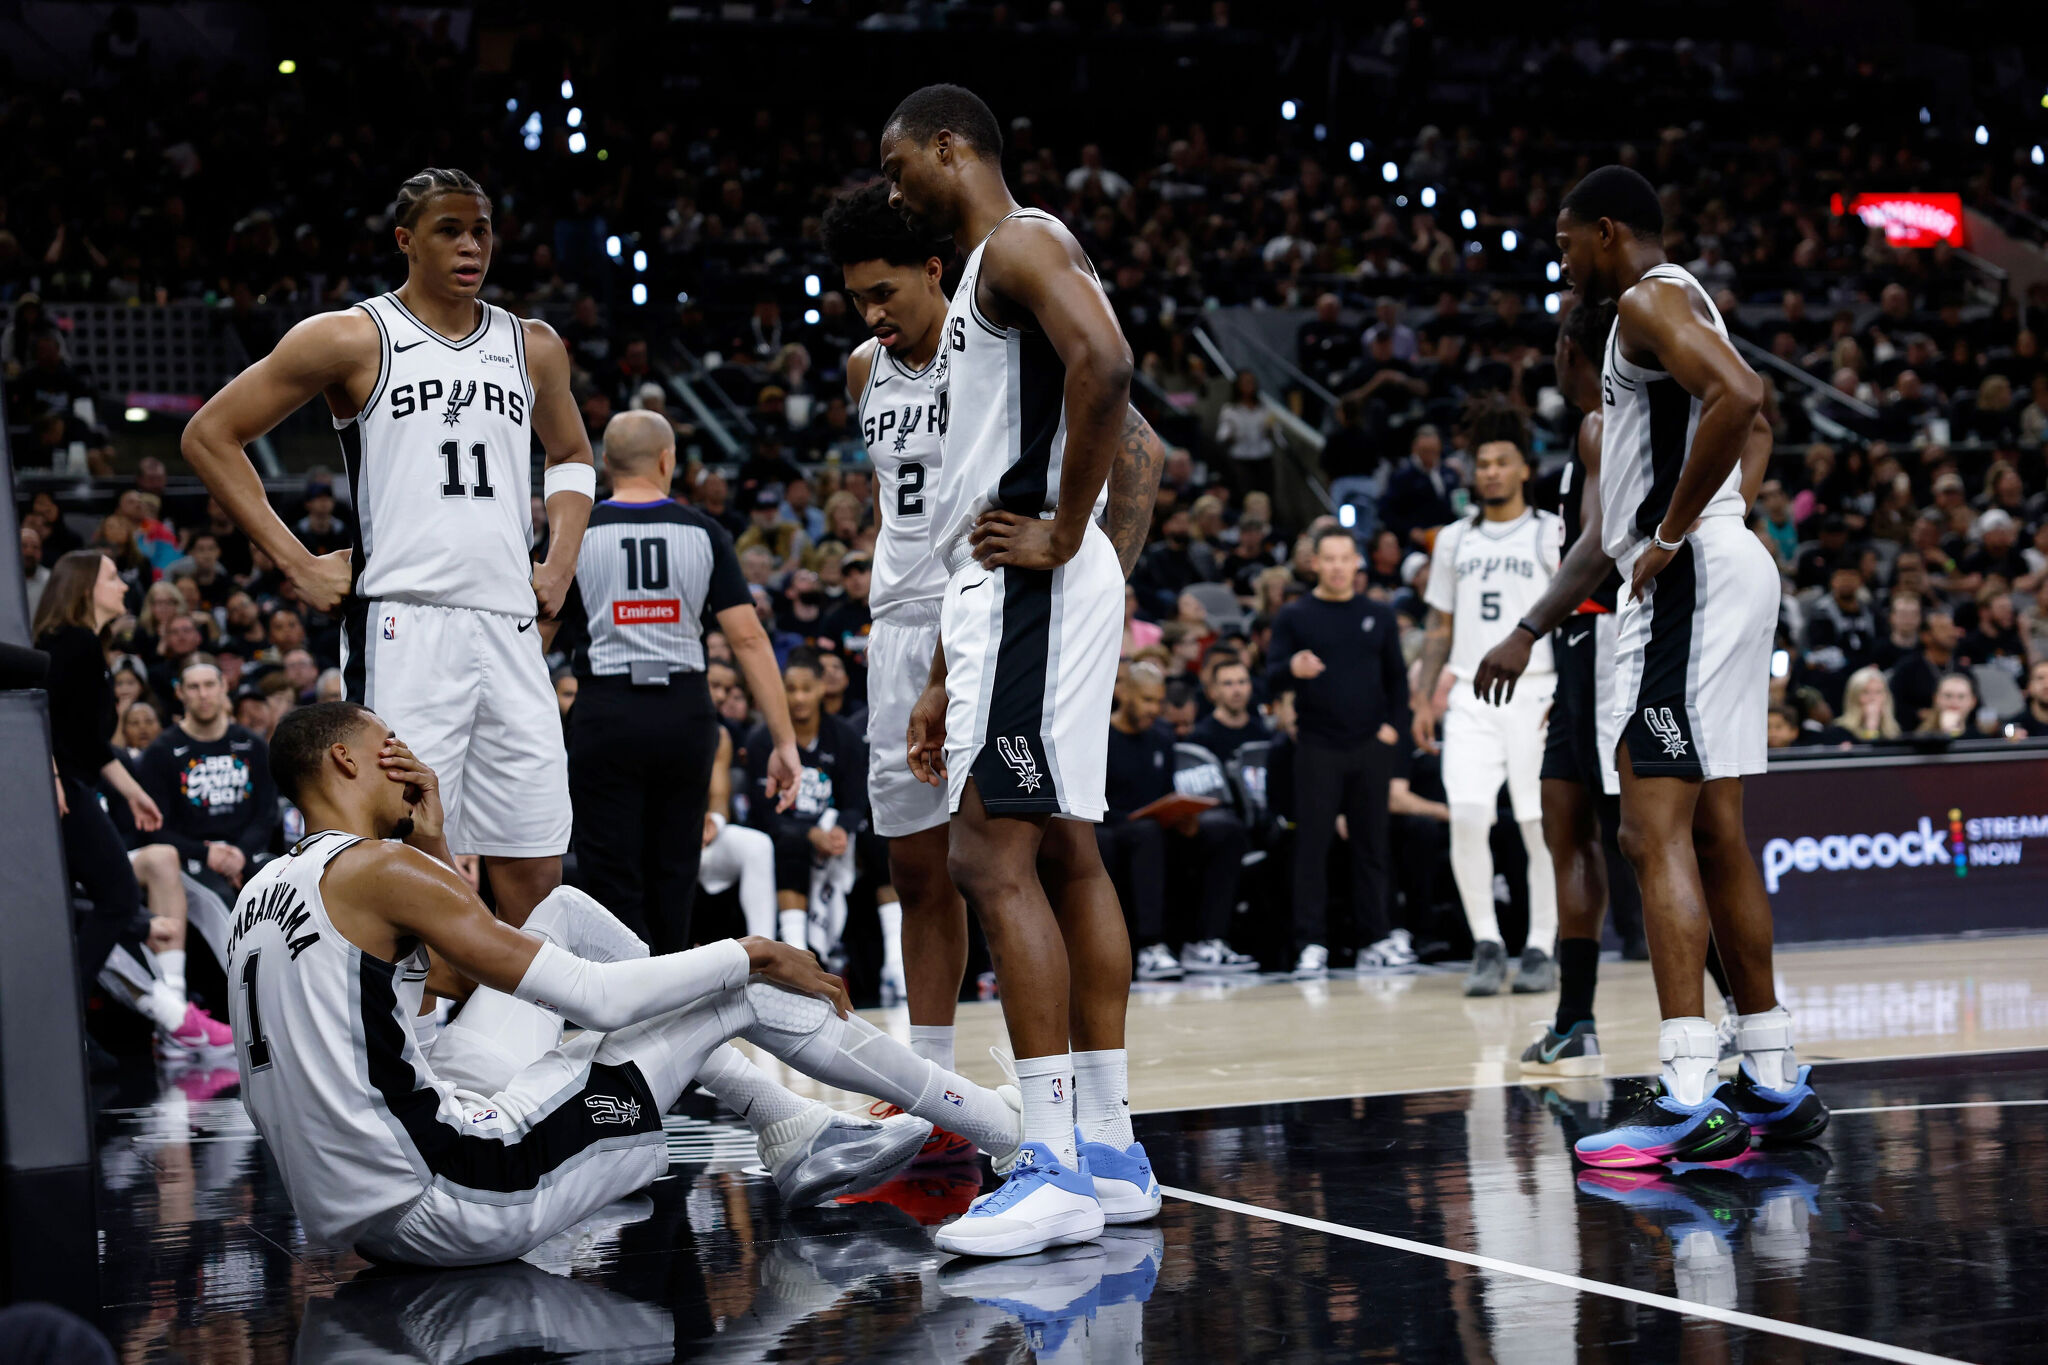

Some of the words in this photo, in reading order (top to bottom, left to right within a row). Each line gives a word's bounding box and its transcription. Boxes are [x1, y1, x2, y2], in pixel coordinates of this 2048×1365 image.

[484, 354, 510, 364] LEDGER
[390, 379, 525, 428] SPURS
[438, 438, 496, 500] 11
[896, 461, 927, 518] 2
[621, 537, 669, 590] 10
[1456, 556, 1535, 581] SPURS
[618, 604, 675, 620] Emirates
[1481, 592, 1501, 621] 5
[1763, 816, 1952, 894] peacock
[1968, 841, 2022, 866] NOW
[240, 948, 273, 1074] 1
